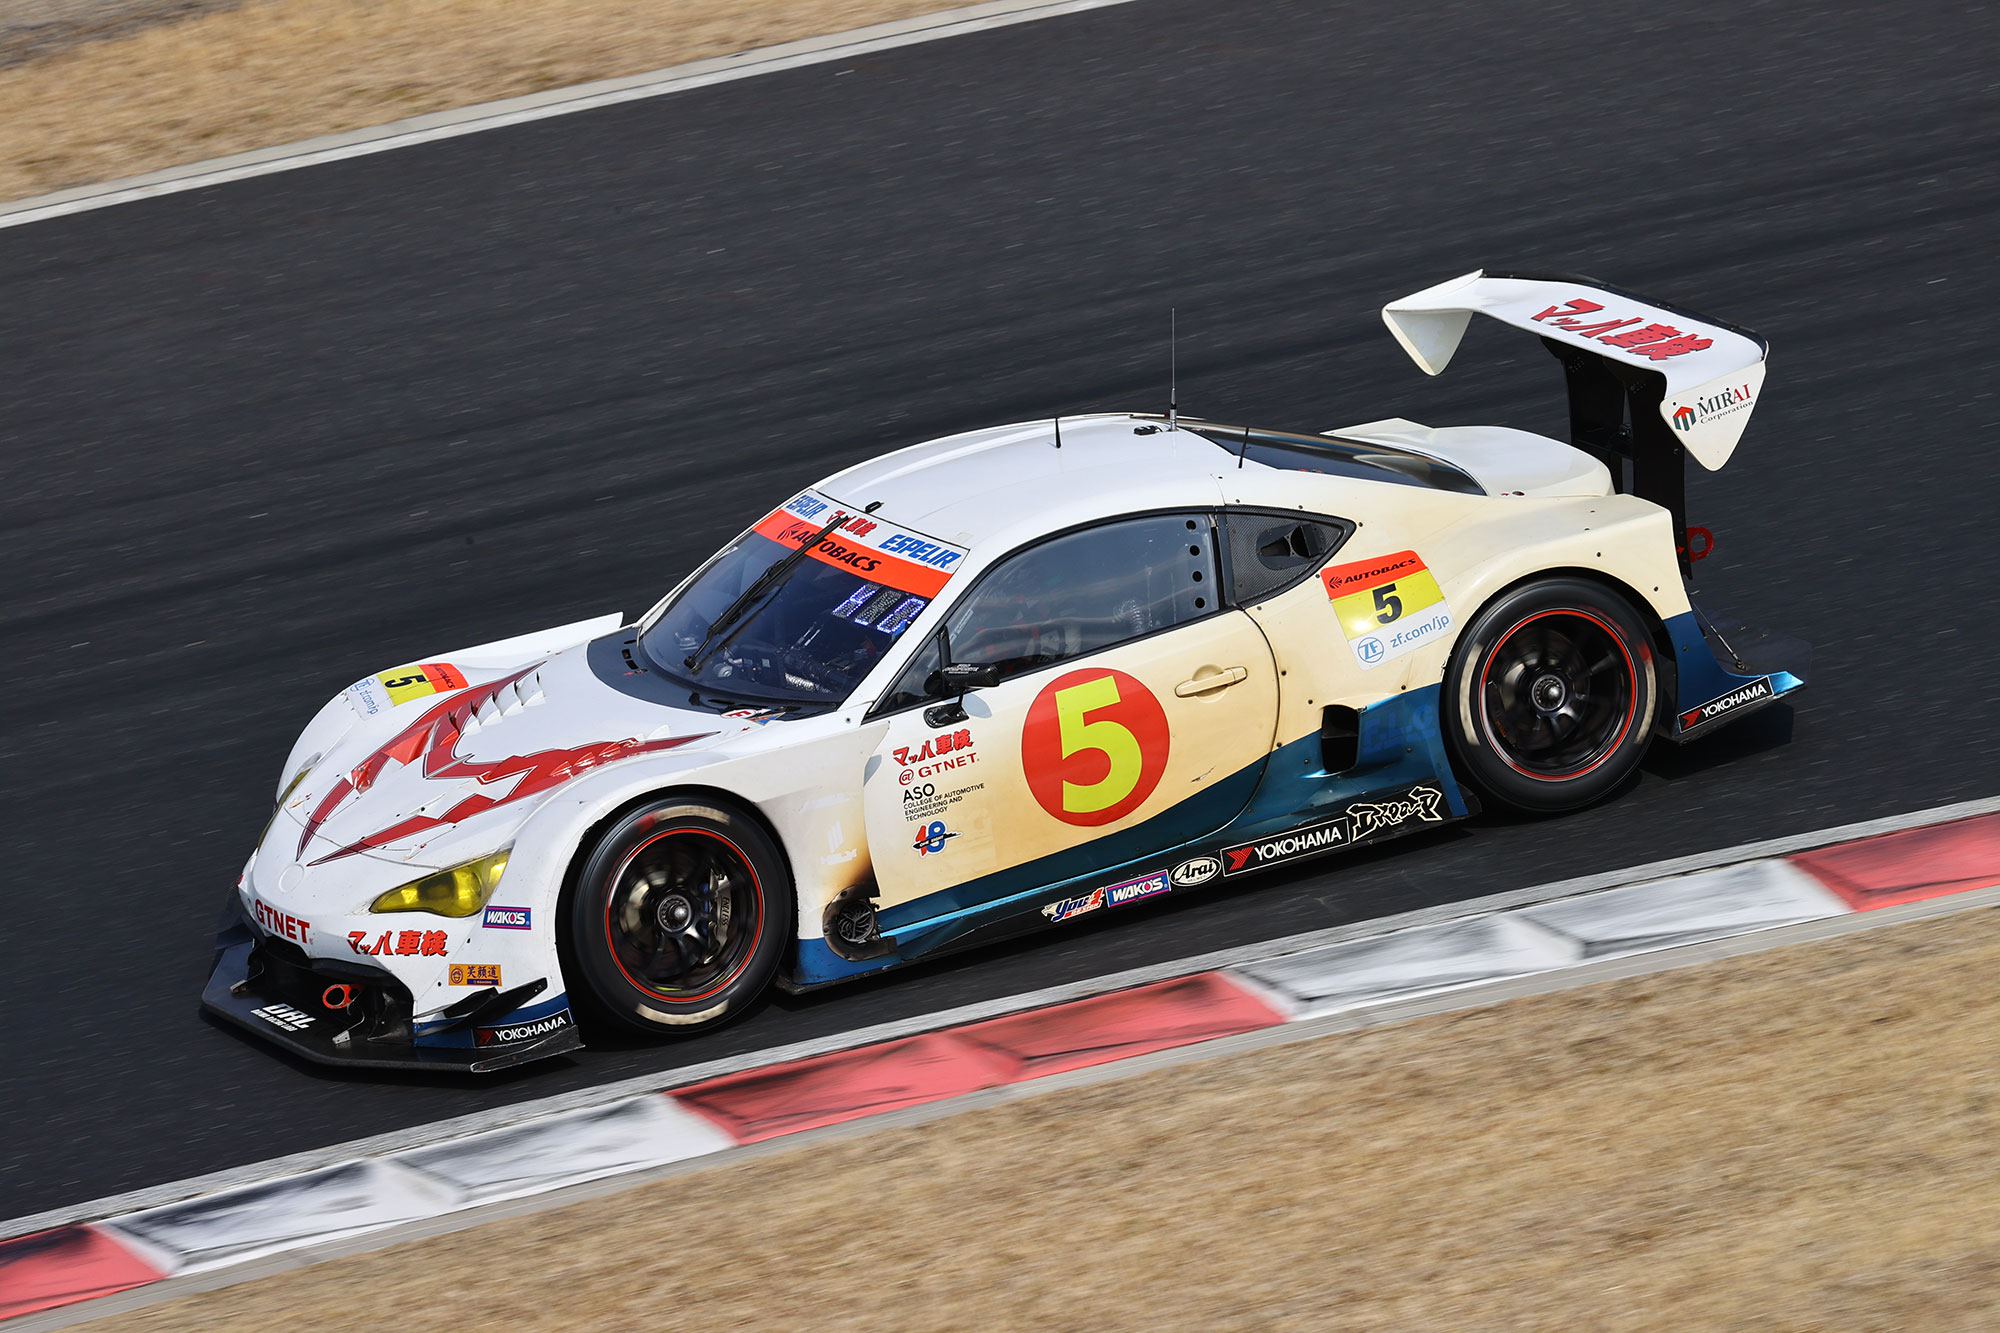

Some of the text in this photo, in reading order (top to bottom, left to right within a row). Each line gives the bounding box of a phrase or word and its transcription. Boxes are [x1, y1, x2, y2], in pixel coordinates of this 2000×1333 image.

[1697, 383, 1751, 417] MIRAI
[1700, 400, 1754, 425] Corporation
[878, 533, 962, 569] ESPELIR
[1344, 557, 1416, 584] AUTOBACS
[1372, 583, 1403, 625] 5
[1390, 615, 1450, 648] zf.com/jp
[384, 674, 428, 689] 5
[1701, 684, 1768, 718] YOKOHAMA
[892, 728, 974, 766] マッハ車検
[1055, 675, 1143, 814] 5
[902, 783, 936, 804] ASO
[903, 783, 985, 810] COLLEGE OF AUTOMOTIVE
[904, 795, 963, 817] ENGINEERING AND
[905, 806, 949, 822] TECHNOLOGY
[1254, 826, 1343, 861] YOKOHAMA
[1174, 859, 1215, 882] Arai
[255, 898, 311, 944] GTNET
[347, 929, 449, 957] マッハ車検
[495, 1016, 567, 1041] YOKOHAMA
